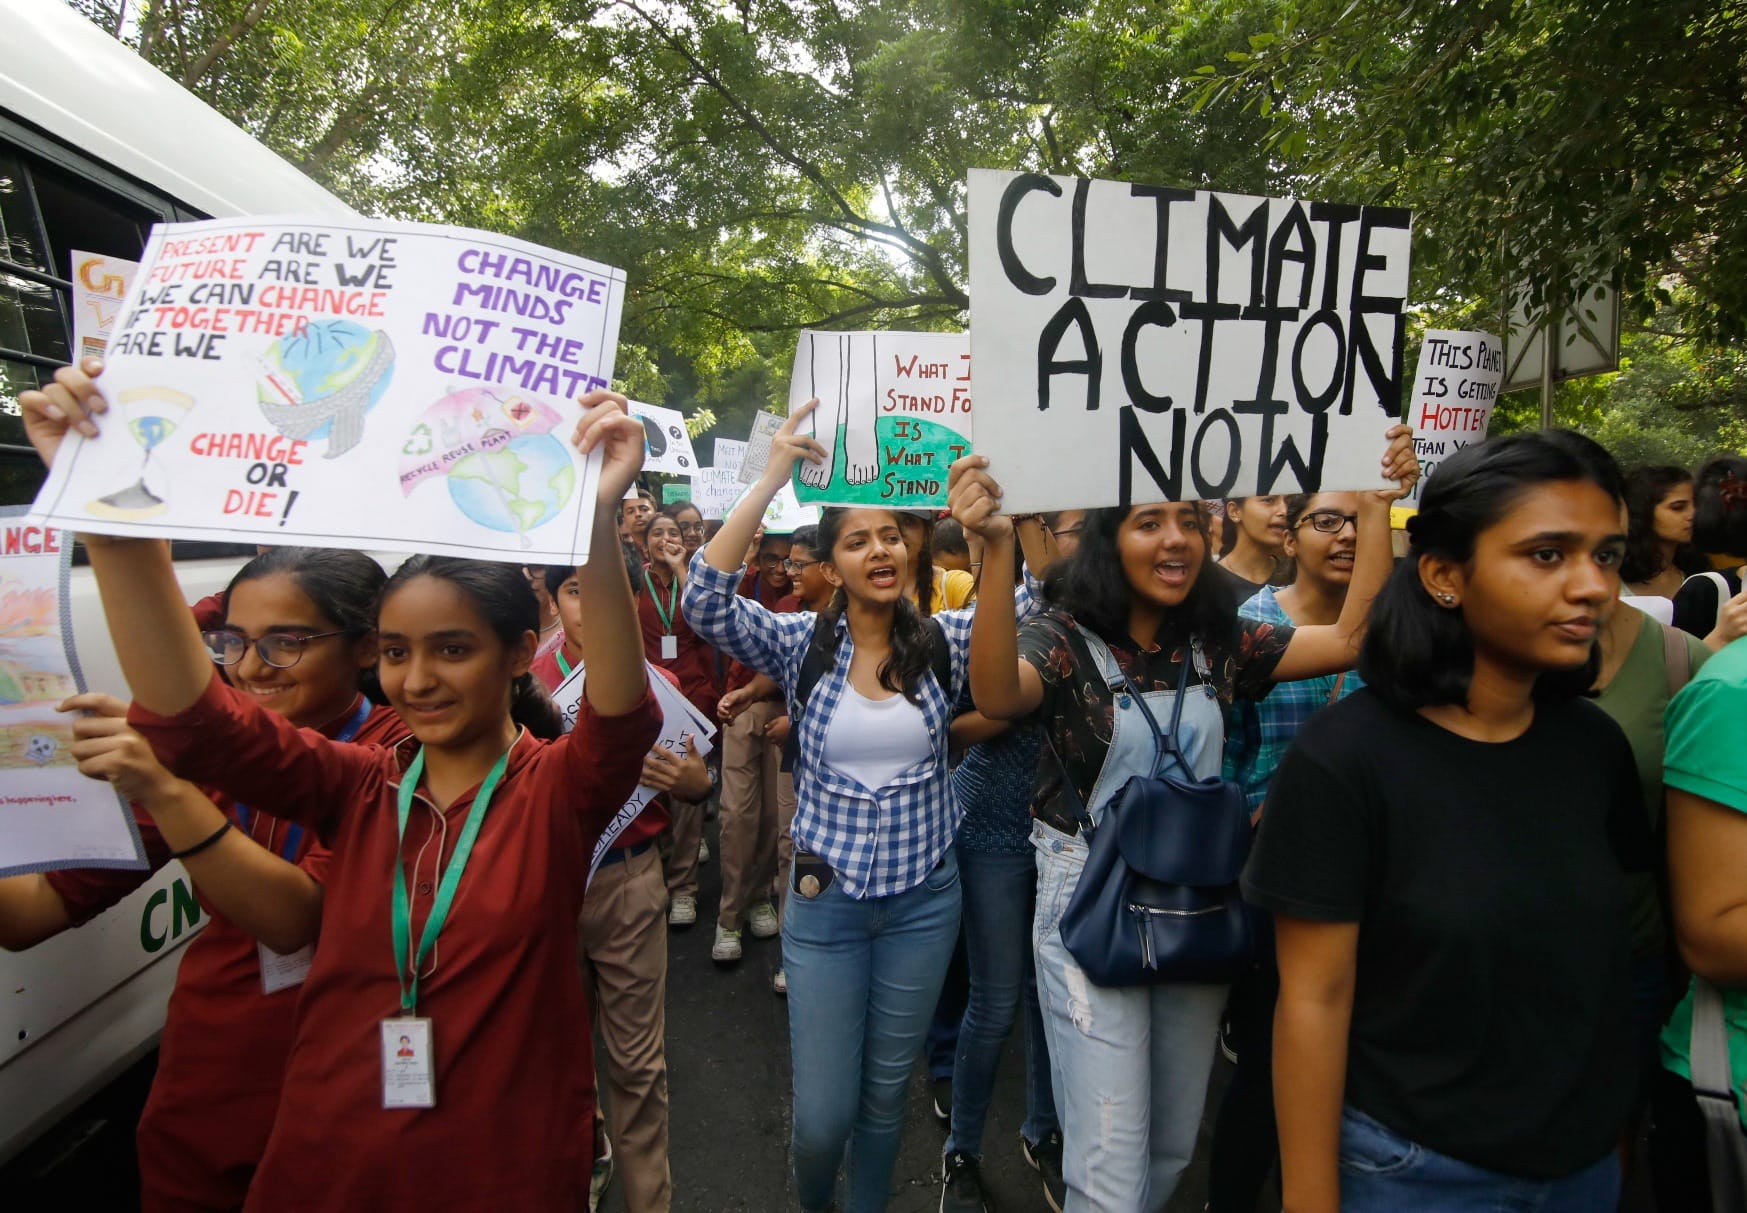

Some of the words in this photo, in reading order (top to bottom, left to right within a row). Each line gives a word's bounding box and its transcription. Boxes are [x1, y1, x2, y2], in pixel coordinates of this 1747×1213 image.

[160, 232, 265, 261] PRESENT
[272, 232, 331, 256] ARE
[346, 235, 398, 261] WE
[997, 173, 1411, 311] CLIMATE
[147, 259, 247, 284] FUTURE
[258, 260, 320, 285] ARE
[334, 263, 397, 289] WE
[457, 249, 606, 304] CHANGE
[140, 284, 182, 306] WE
[189, 283, 254, 305] CAN
[258, 285, 386, 316] CHANGE
[452, 282, 573, 325] MINDS
[125, 308, 150, 330] IF
[154, 306, 309, 339] TOGETHER
[110, 331, 167, 356] ARE
[174, 332, 226, 360] WE
[422, 312, 500, 344] NOT
[511, 327, 584, 365] THE
[895, 354, 948, 379] WHAT
[1038, 296, 1406, 417] ACTION
[1428, 339, 1473, 370] THIS
[883, 388, 945, 413] STAND
[951, 388, 971, 413] FO
[1422, 377, 1448, 397] IS
[1457, 379, 1496, 400] GETTING
[894, 421, 921, 441] IS
[1420, 403, 1485, 431] HOTTER
[190, 433, 308, 465] CHANGE
[442, 443, 474, 463] REUSE
[885, 445, 935, 466] WHAT
[1120, 405, 1328, 507] NOW
[1412, 438, 1445, 455] THAN
[246, 462, 288, 487] OR
[880, 472, 939, 498] STAND
[223, 489, 299, 527] DIE!
[0, 526, 60, 555] NGE
